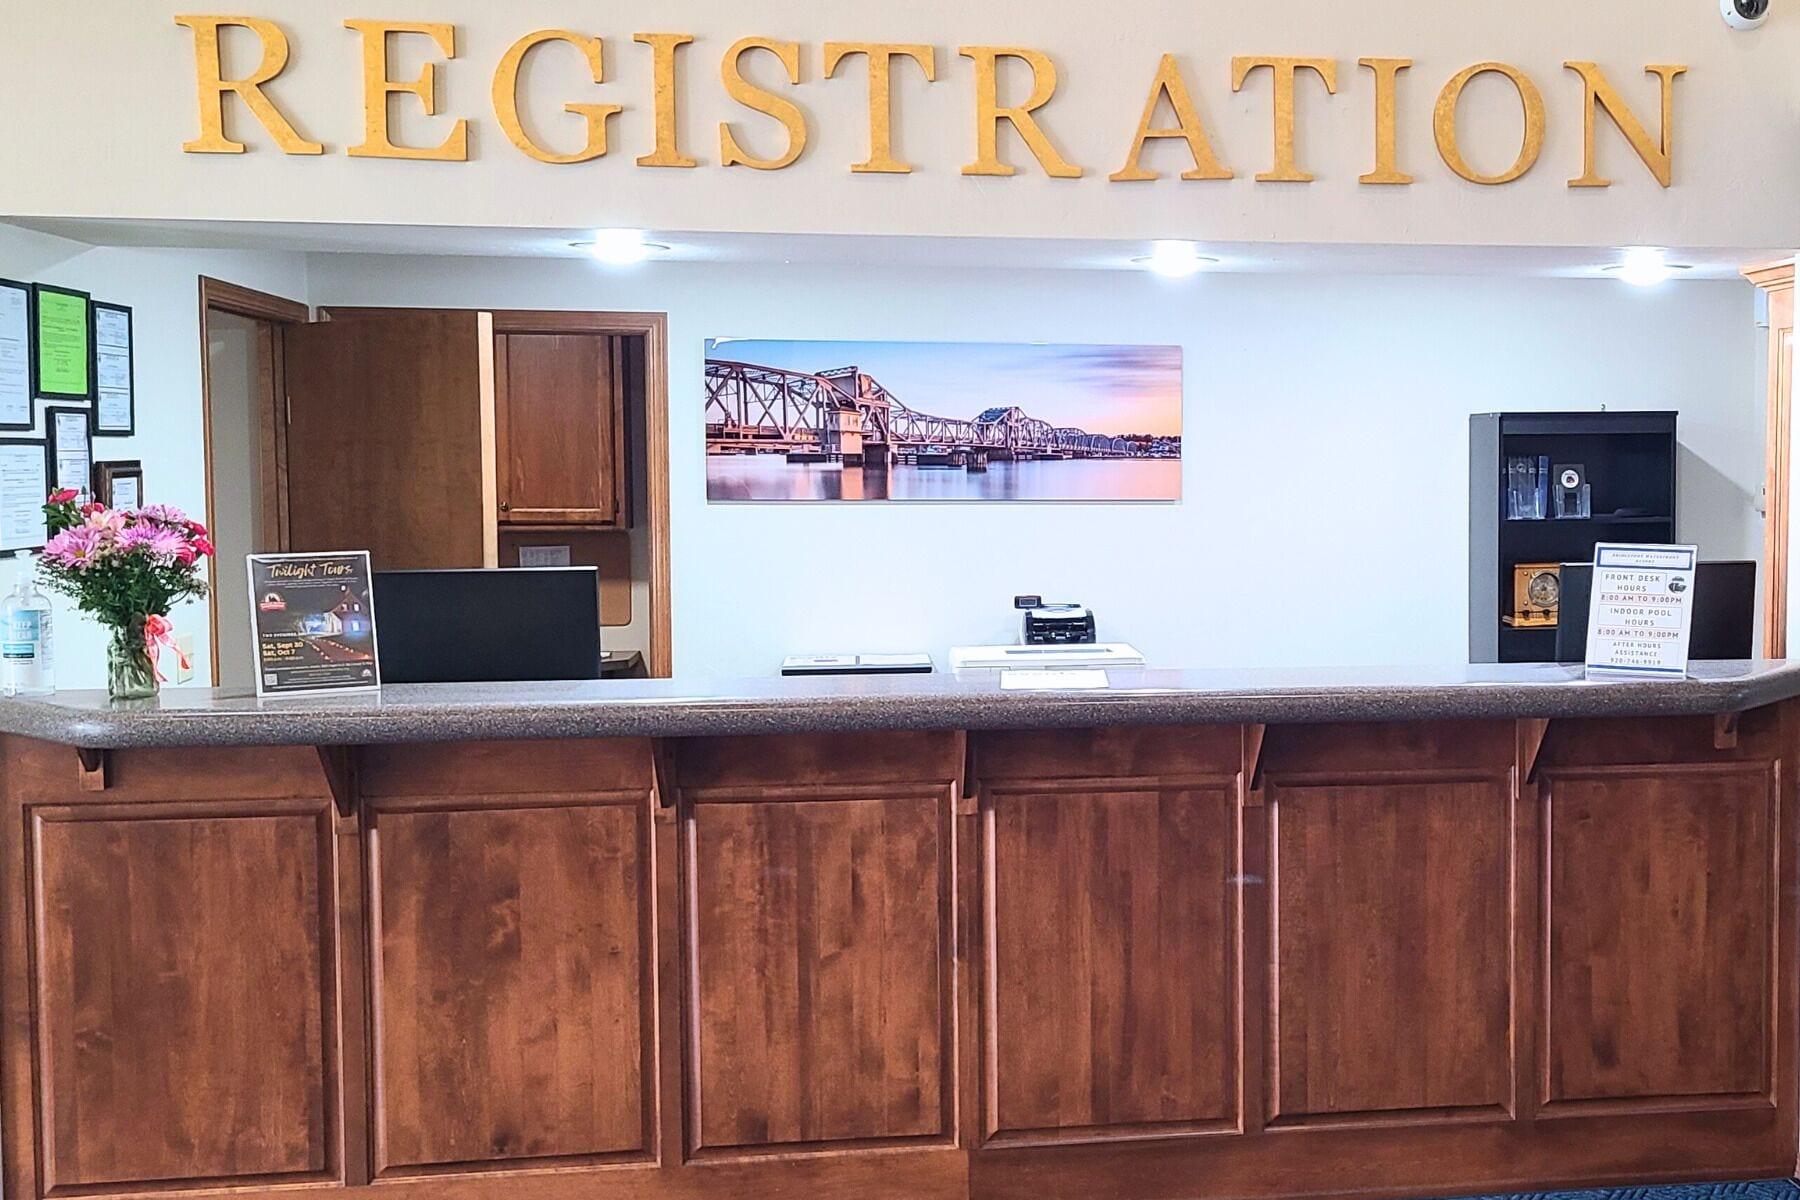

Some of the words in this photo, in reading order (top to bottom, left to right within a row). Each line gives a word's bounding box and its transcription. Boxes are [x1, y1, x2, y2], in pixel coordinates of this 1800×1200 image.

[174, 15, 1688, 189] REGISTRATION
[266, 562, 317, 579] Twilight
[320, 561, 354, 576] Tours
[1617, 584, 1647, 592] HOURS
[1610, 607, 1644, 615] INDOOR
[1614, 649, 1658, 657] ASSISTANCE
